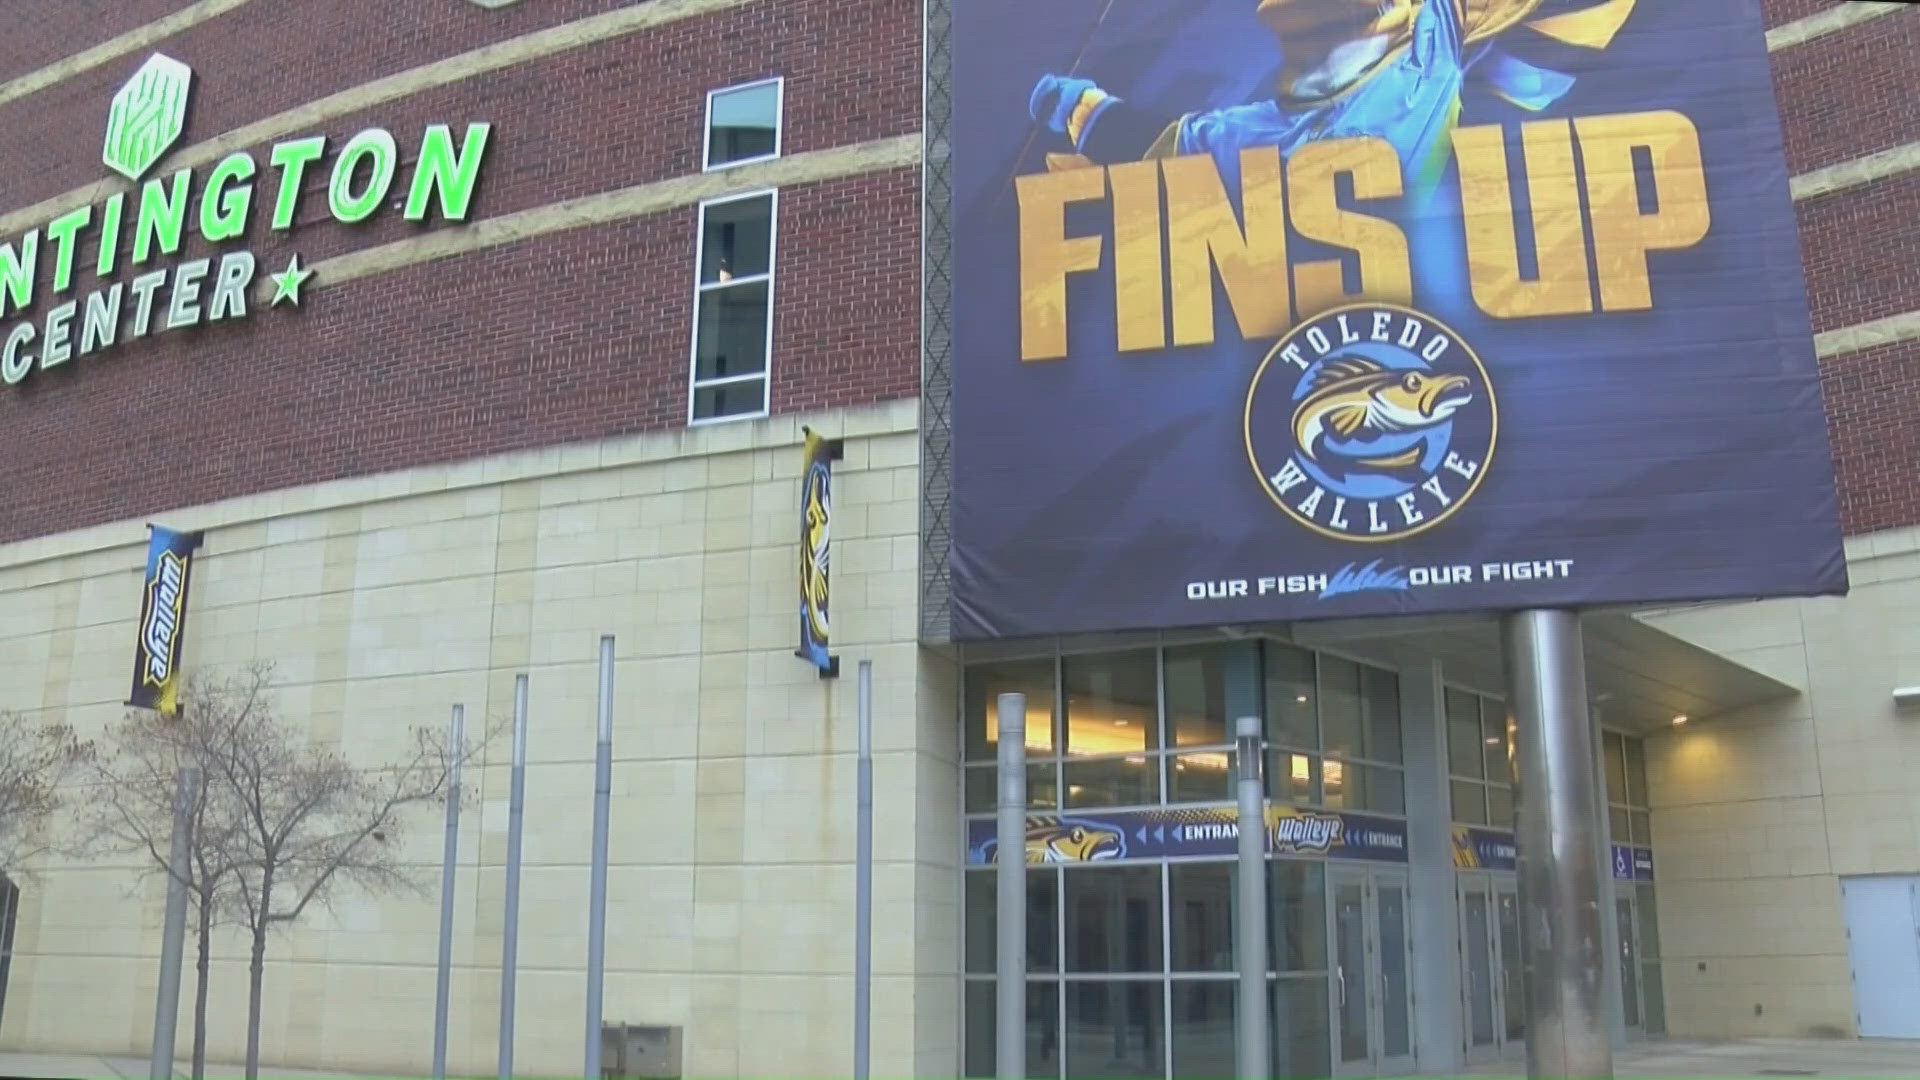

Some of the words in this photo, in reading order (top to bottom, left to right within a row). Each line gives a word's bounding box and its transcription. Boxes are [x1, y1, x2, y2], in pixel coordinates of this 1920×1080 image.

[1015, 136, 1412, 361] FINS
[1451, 110, 1711, 318] UP
[2, 250, 256, 384] CENTER
[1280, 311, 1449, 371] TOLEDO
[1270, 450, 1478, 533] WALLEYE
[1187, 579, 1248, 600] OUR
[1258, 573, 1328, 596] FISH
[1409, 564, 1473, 586] OUR
[1483, 559, 1574, 582] FIGHT
